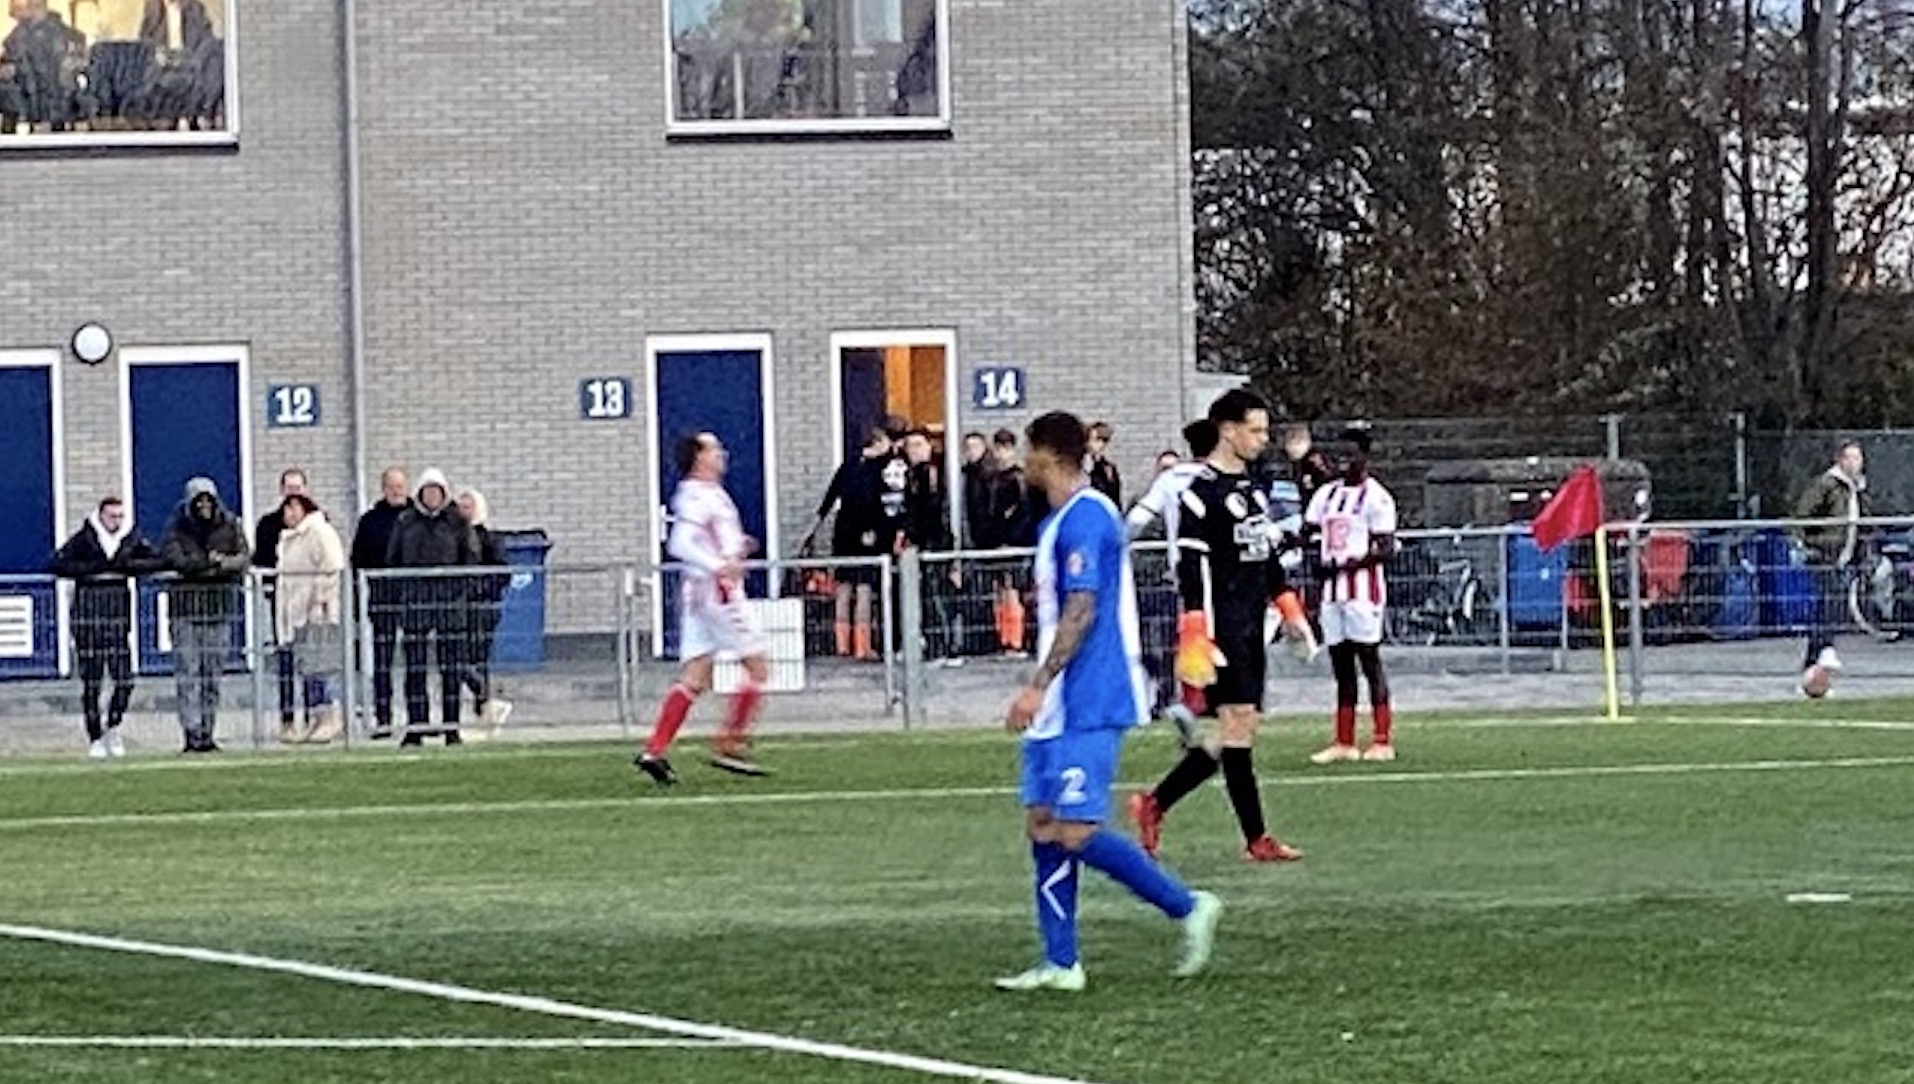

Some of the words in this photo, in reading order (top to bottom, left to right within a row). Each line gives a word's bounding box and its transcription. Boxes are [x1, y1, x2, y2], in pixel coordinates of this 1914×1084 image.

[275, 386, 314, 423] 12
[588, 380, 623, 417] 13
[980, 370, 1019, 407] 14
[1057, 766, 1087, 806] 2
